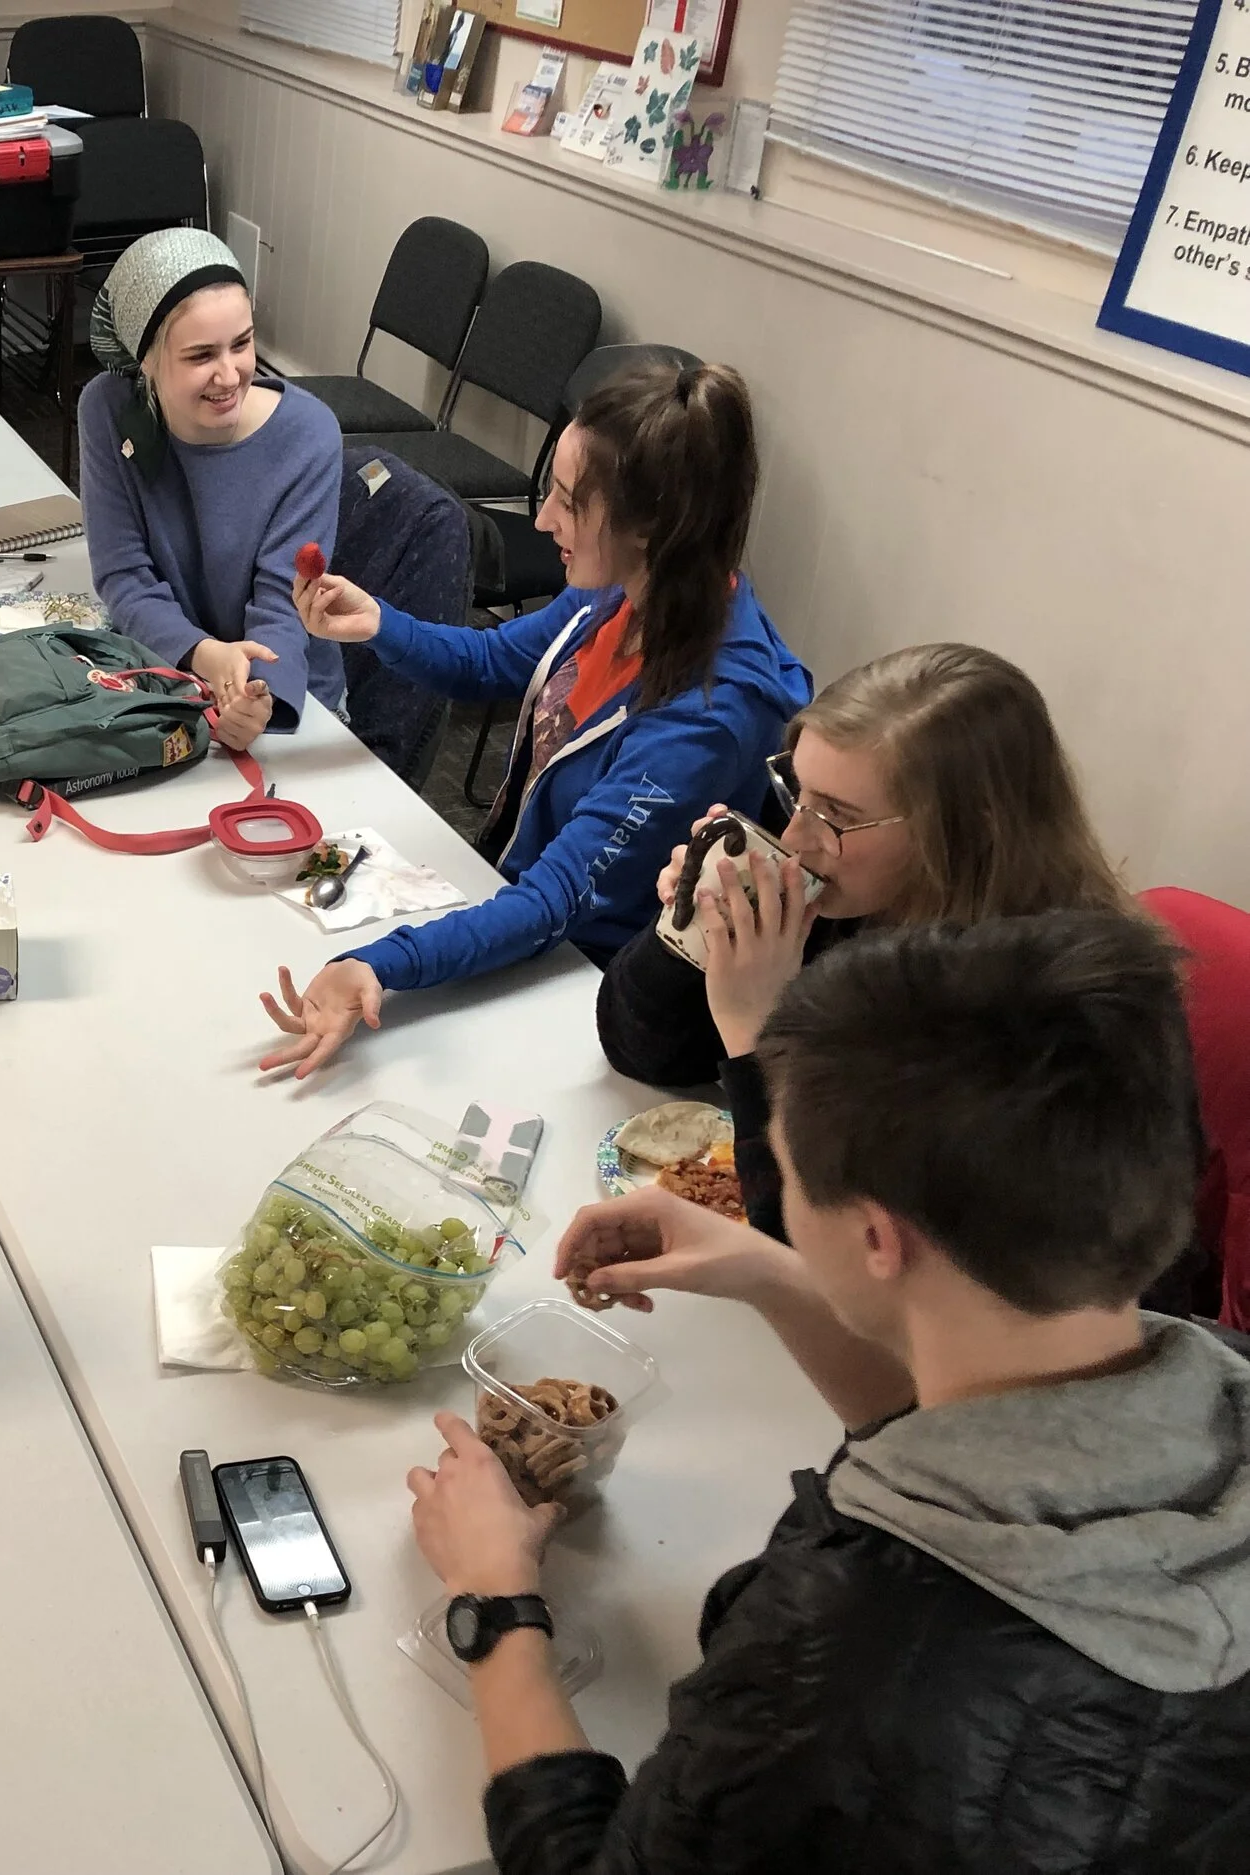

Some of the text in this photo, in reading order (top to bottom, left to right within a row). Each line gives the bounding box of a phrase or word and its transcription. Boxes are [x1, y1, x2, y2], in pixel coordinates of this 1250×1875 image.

[1215, 53, 1230, 75] 5.
[1185, 145, 1250, 184] 6. Keep
[1165, 205, 1179, 228] 7.
[1174, 243, 1239, 276] other's
[65, 772, 115, 796] Astronomy
[296, 1160, 327, 1180] GREEN
[327, 1174, 371, 1207] SEEDLESS
[340, 1197, 360, 1214] VERTS
